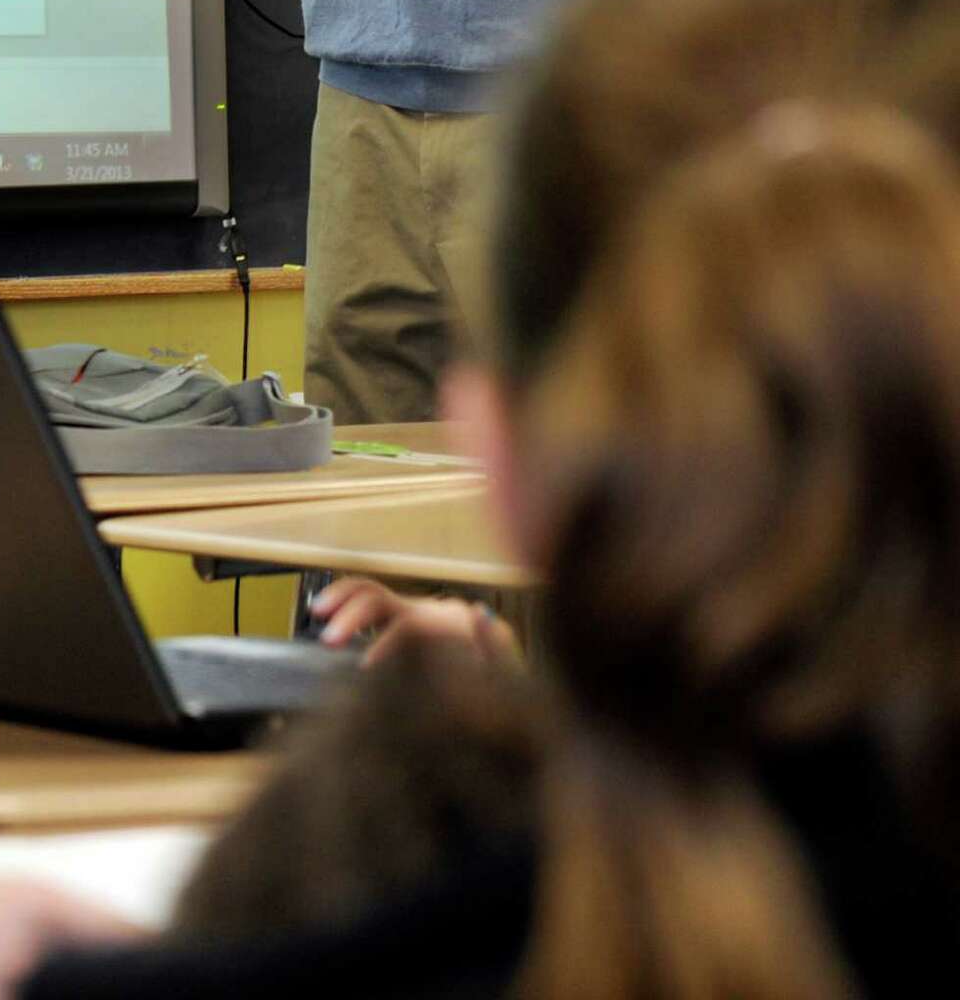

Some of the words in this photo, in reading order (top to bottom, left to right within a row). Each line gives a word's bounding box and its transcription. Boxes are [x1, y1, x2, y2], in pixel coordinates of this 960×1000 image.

[66, 142, 100, 158] 11:45
[105, 141, 129, 157] AM
[65, 165, 133, 183] 3/21/2013
